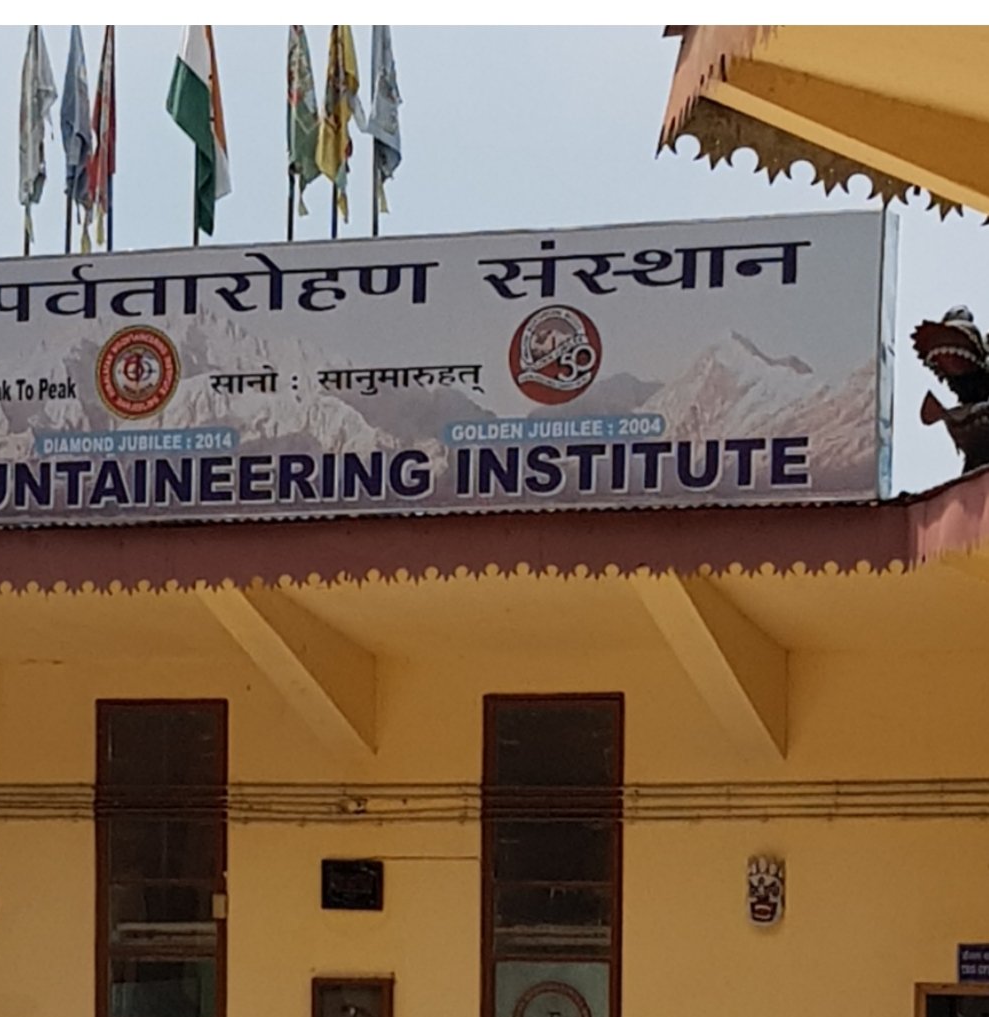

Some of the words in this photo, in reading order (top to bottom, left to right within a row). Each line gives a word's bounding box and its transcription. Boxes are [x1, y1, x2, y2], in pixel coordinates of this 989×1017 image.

[479, 240, 811, 299] संस्थान
[16, 379, 34, 400] To
[38, 377, 76, 399] Peak
[209, 365, 278, 394] सानो
[451, 423, 523, 440] GOLDEN
[528, 419, 602, 438] JUBILEE
[618, 418, 660, 435] 2004
[44, 436, 114, 454] DIAMOND
[118, 434, 182, 451] JUBILEE
[195, 433, 232, 449] 2014
[456, 436, 809, 496] INSTITUTE
